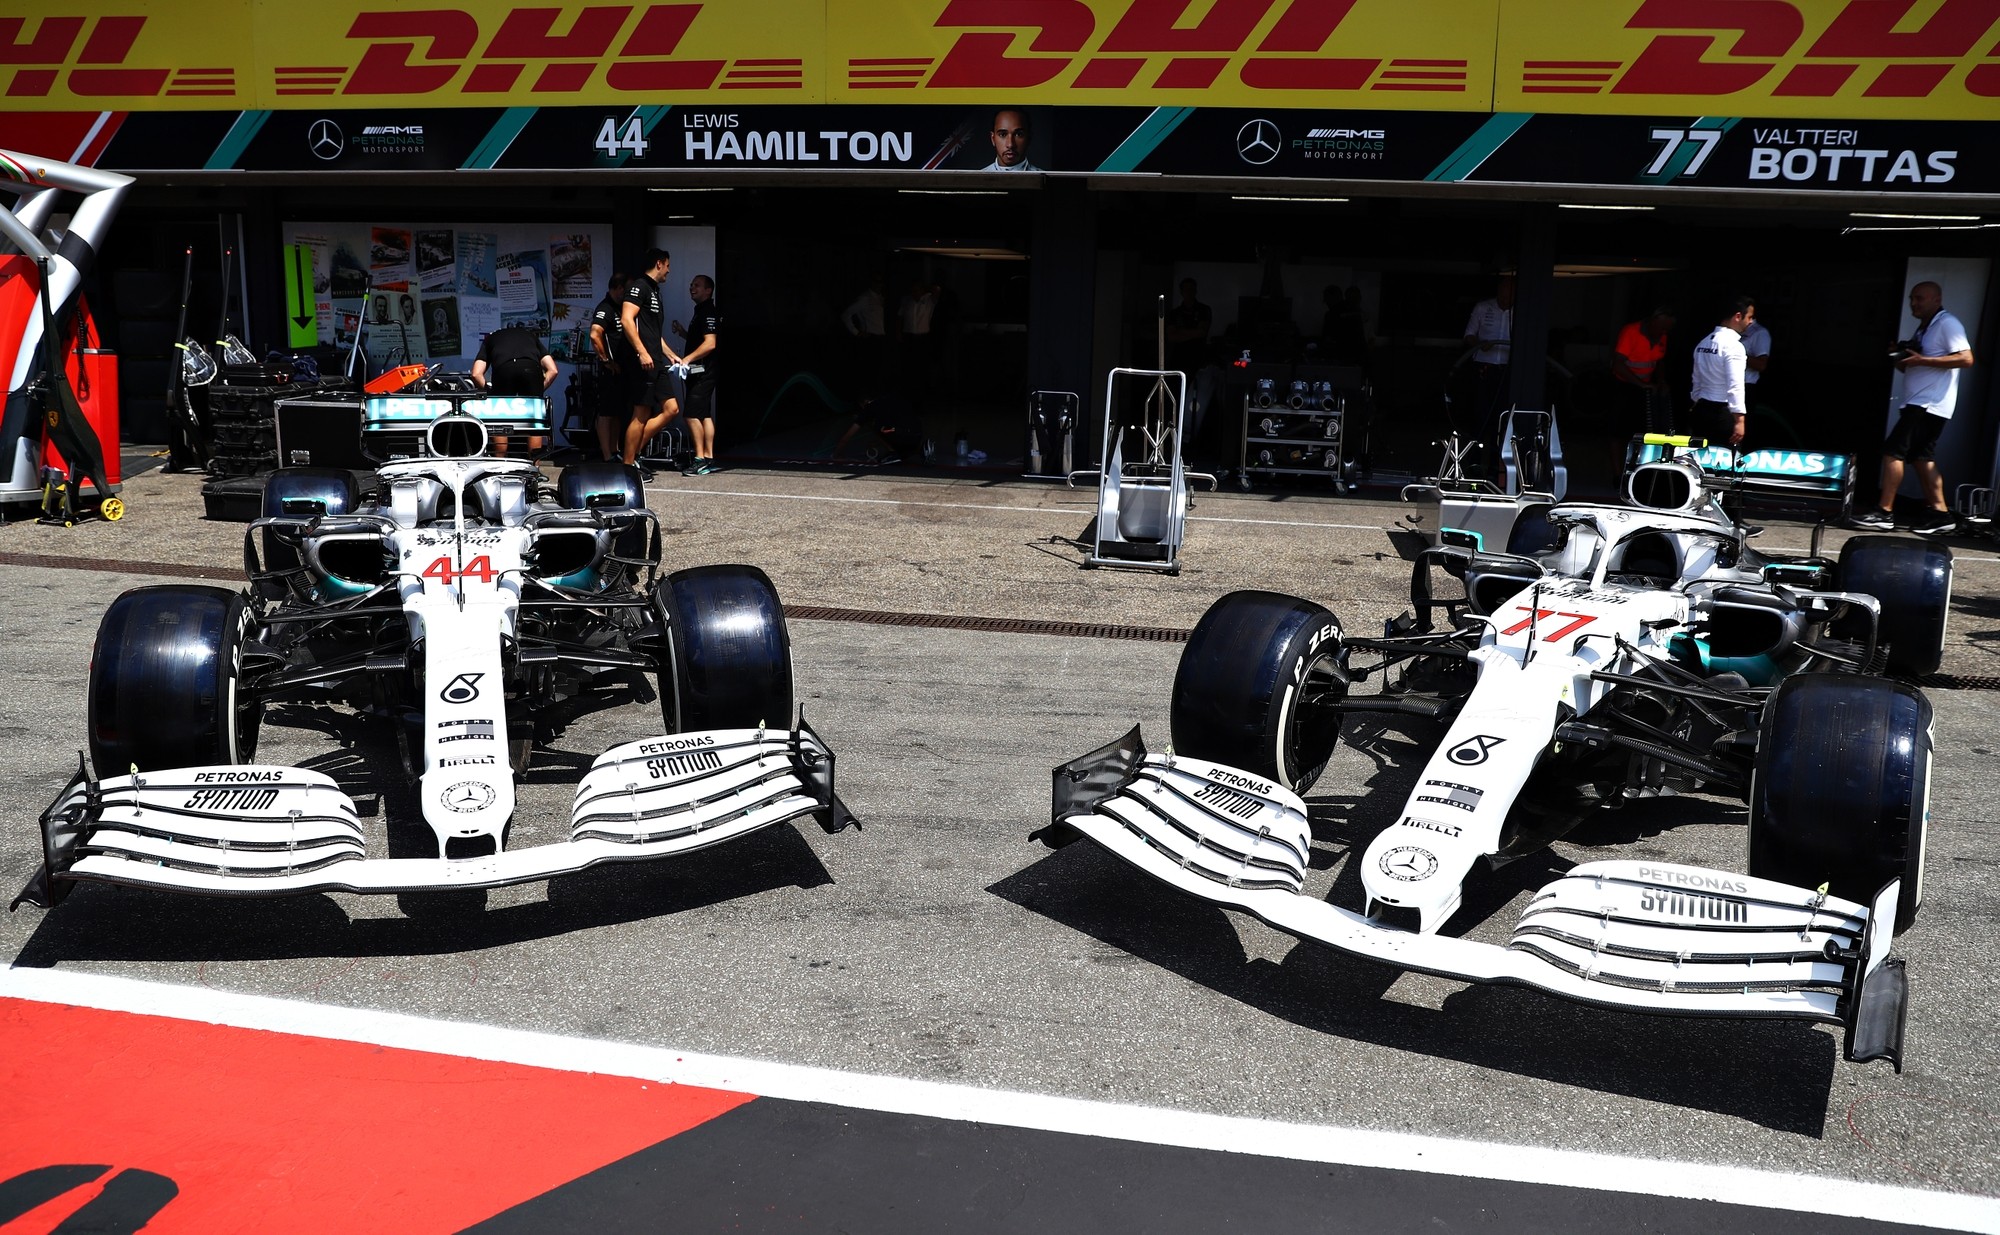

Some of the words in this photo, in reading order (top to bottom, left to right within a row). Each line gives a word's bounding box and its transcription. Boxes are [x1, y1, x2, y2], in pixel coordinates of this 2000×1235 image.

[343, 4, 726, 95] DHL
[927, 0, 1381, 90] DHL
[683, 114, 739, 128] LEWIS
[352, 136, 425, 146] PETRONAS
[595, 118, 648, 157] 44
[685, 131, 912, 162] HAMILTON
[1292, 139, 1384, 151] PETRONAS
[1753, 128, 1858, 146] VALTTERI
[1304, 151, 1383, 160] MOTORSPORT
[1647, 129, 1722, 178] 77
[1748, 147, 1957, 183] BOTTAS
[422, 555, 499, 585] 44
[237, 606, 257, 641] ZER
[1500, 606, 1598, 642] 77
[441, 719, 491, 727] TOMMY
[441, 734, 492, 743] HILFIGER
[639, 735, 715, 755] PETRONAS
[439, 755, 495, 768] PIRELLI
[194, 771, 283, 783] PETRONAS
[1207, 768, 1273, 796] PETRONAS
[1428, 780, 1482, 795] TOMMY
[1418, 796, 1473, 812] HILFIGER
[1401, 816, 1463, 838] PIRELLI
[1638, 866, 1748, 894] PETRONAS
